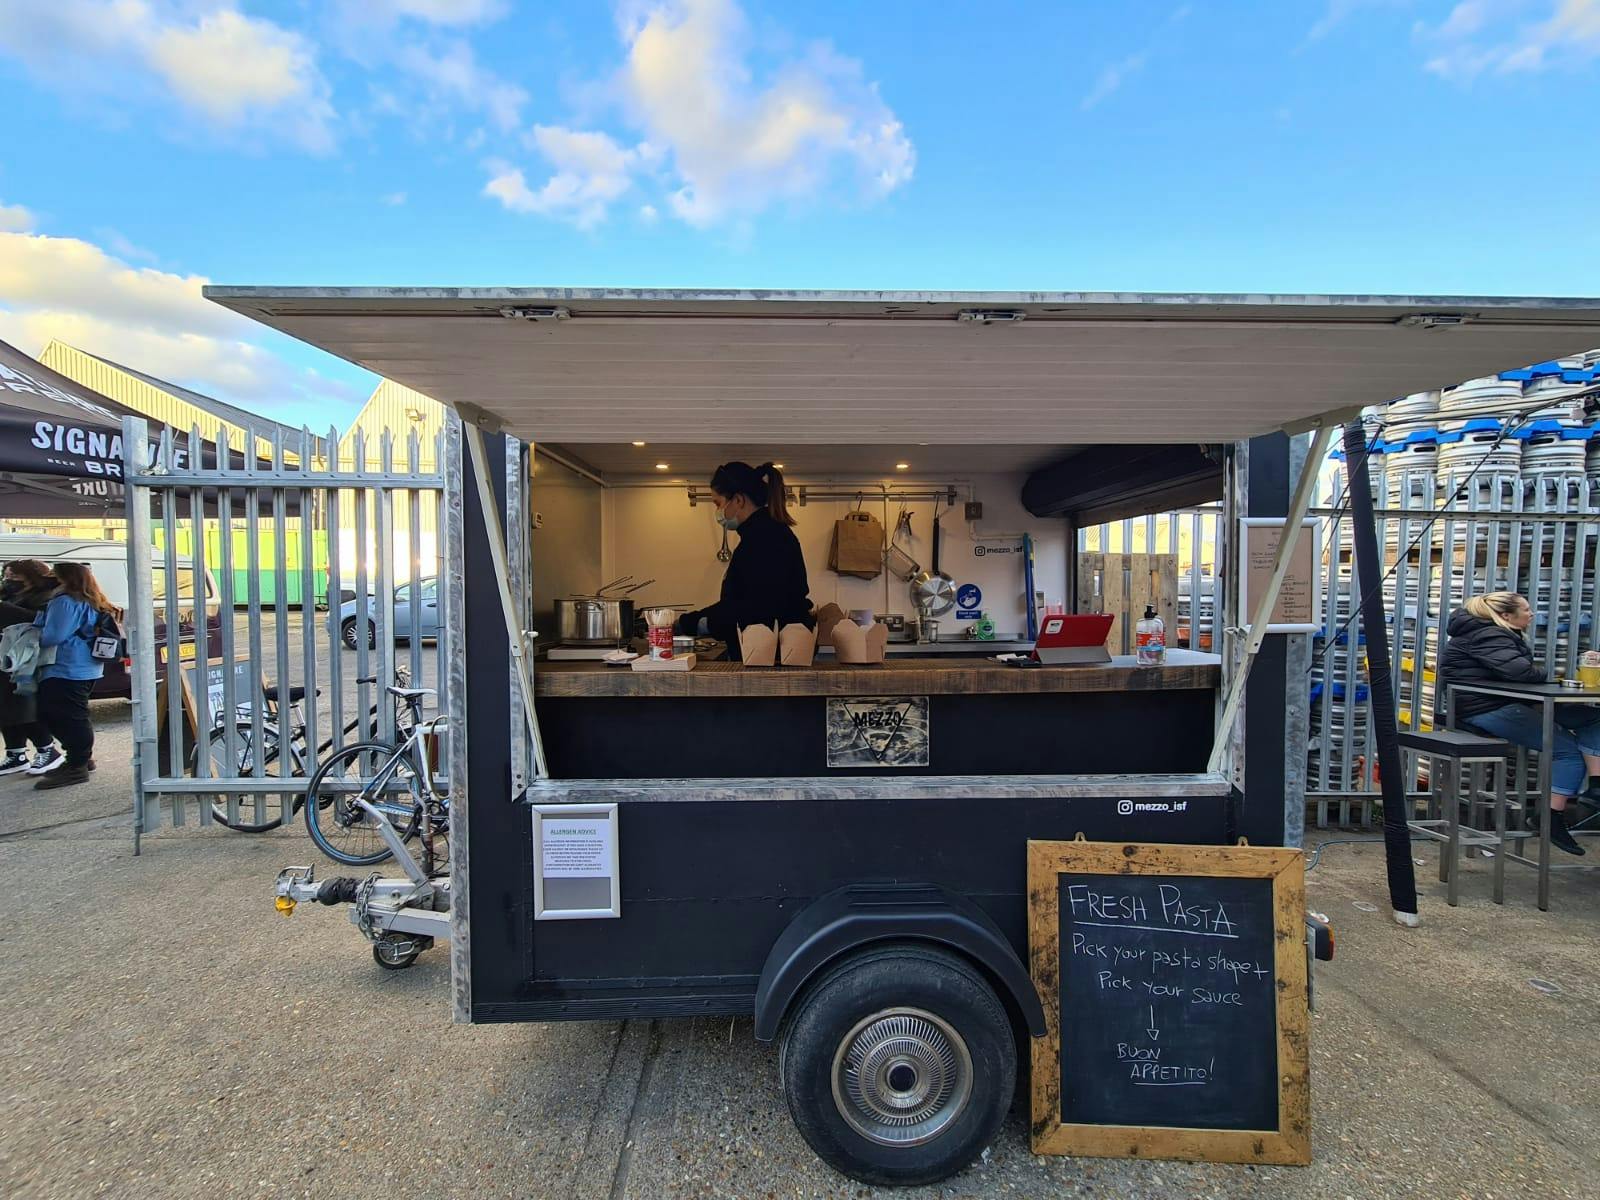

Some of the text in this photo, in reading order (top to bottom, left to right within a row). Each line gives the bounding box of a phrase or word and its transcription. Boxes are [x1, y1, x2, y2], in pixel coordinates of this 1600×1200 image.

[31, 421, 187, 471] SIGNAE
[853, 710, 902, 727] MEZZO
[1135, 801, 1187, 812] mezzo_isf
[1068, 885, 1238, 935] FRESH PASTA
[1072, 933, 1108, 959] Pick
[1114, 945, 1147, 967] your
[1152, 948, 1201, 974] pasta
[1098, 970, 1133, 990] Pick
[1117, 1042, 1161, 1060] BUON
